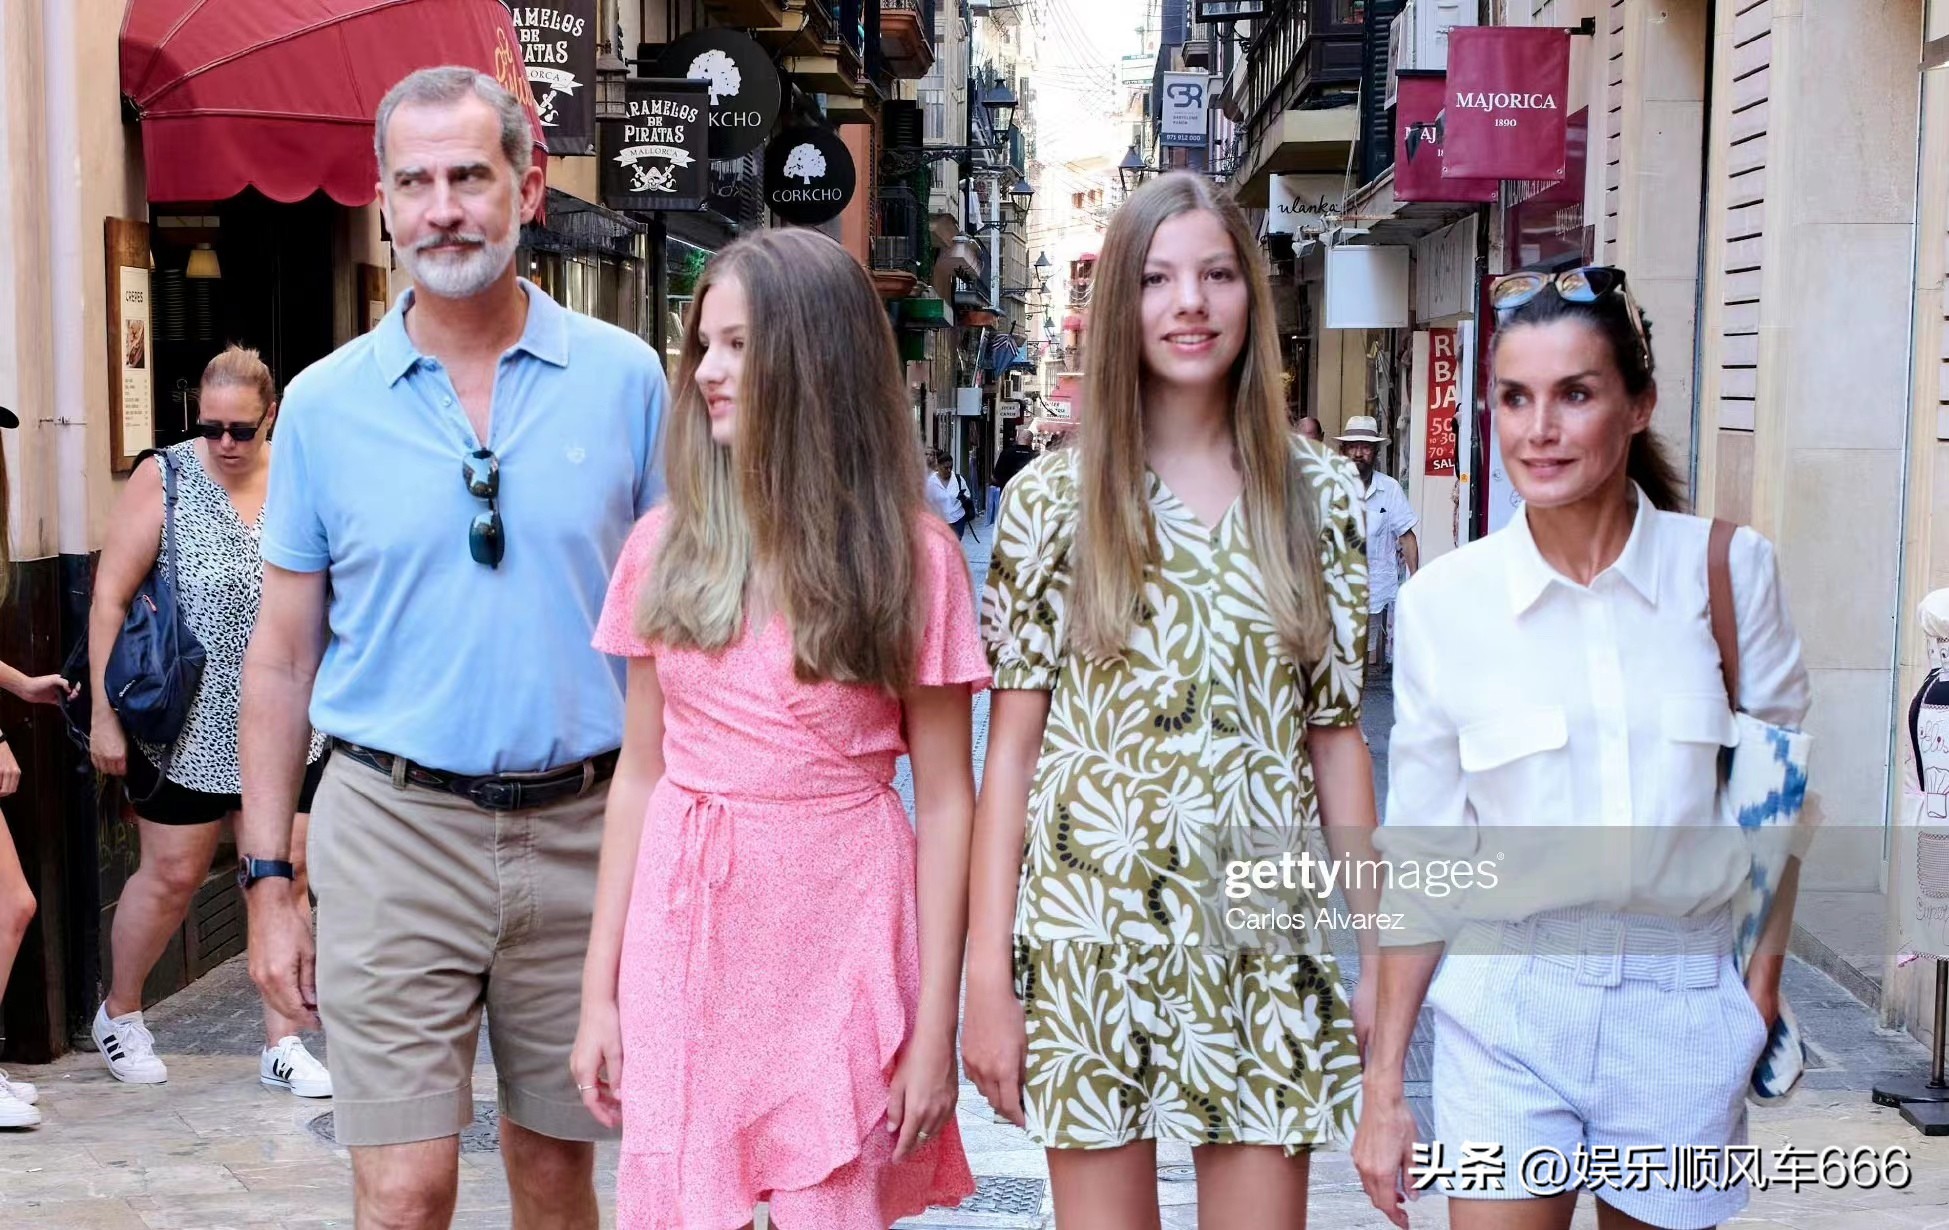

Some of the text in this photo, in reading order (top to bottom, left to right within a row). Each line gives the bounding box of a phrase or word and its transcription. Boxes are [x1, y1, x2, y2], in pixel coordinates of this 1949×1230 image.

[512, 7, 586, 37] AMELOS
[520, 28, 540, 43] DE
[517, 40, 569, 64] ATAS
[527, 69, 560, 82] ORCA
[1455, 92, 1557, 112] MAJORICA
[626, 99, 699, 123] RAMELOS
[708, 110, 762, 128] KCHO
[647, 116, 663, 127] DE
[1494, 118, 1517, 128] 1890
[624, 124, 685, 144] PIRATAS
[630, 148, 678, 158] MALLORCA
[772, 187, 842, 203] CORKCHO
[1433, 458, 1455, 470] SAL
